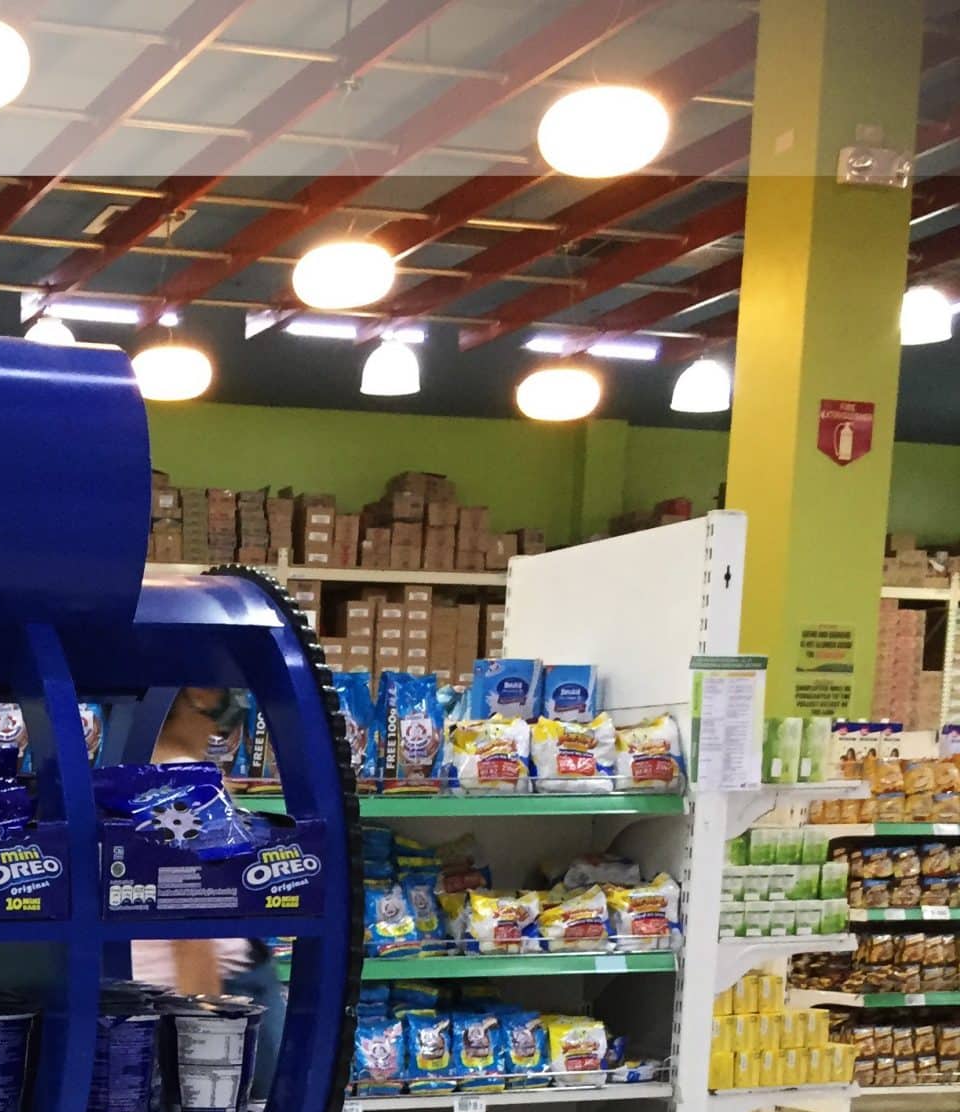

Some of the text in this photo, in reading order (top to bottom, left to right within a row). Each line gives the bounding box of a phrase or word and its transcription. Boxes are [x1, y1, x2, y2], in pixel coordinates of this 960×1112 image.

[253, 738, 265, 767] FREE
[386, 738, 397, 770] FREE
[0, 848, 39, 864] mini
[262, 847, 300, 864] mini
[246, 858, 318, 885] OREO
[10, 880, 50, 896] Original
[5, 897, 23, 911] 10
[265, 895, 281, 908] 10
